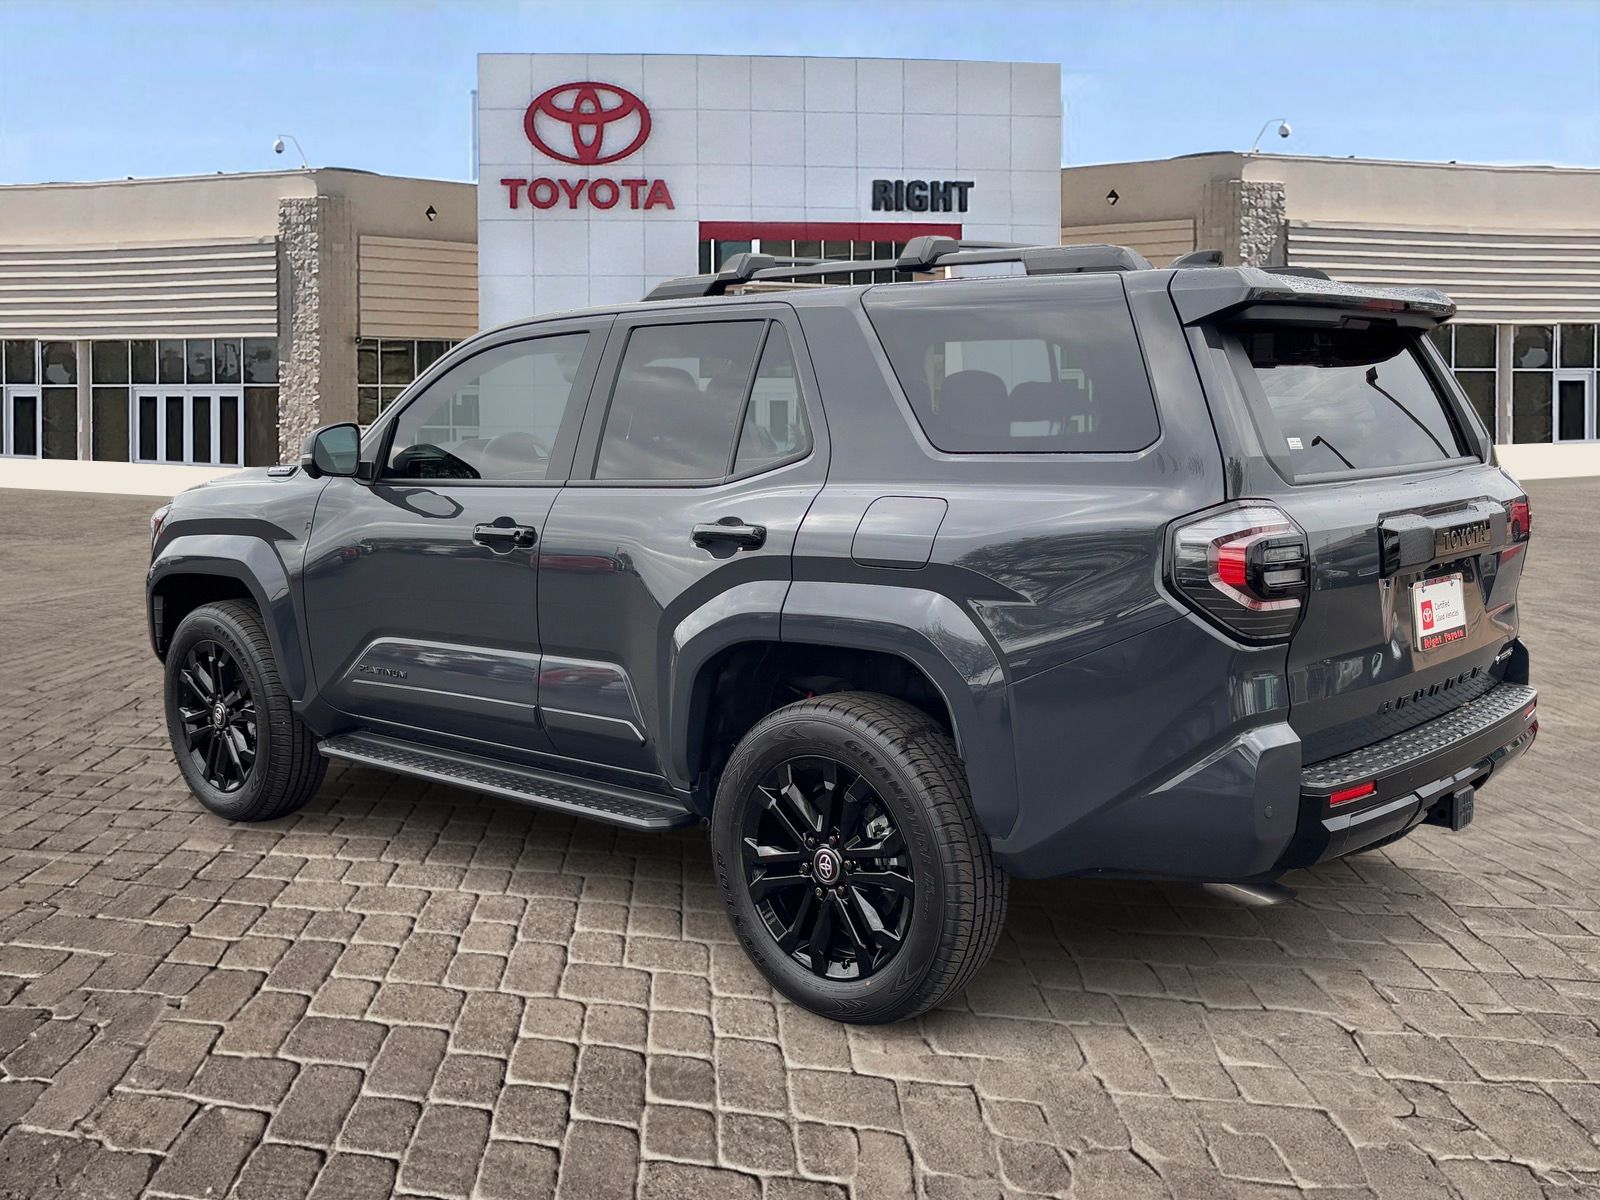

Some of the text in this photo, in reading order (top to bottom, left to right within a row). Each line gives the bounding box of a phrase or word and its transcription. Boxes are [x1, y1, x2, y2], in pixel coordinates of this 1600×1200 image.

[500, 178, 675, 210] TOYOTA
[872, 179, 976, 213] RIGHT
[1443, 524, 1486, 550] TOYOTA
[1434, 600, 1450, 611] Certified
[1424, 629, 1464, 649] Right Toyota
[359, 664, 408, 680] PLATINUM
